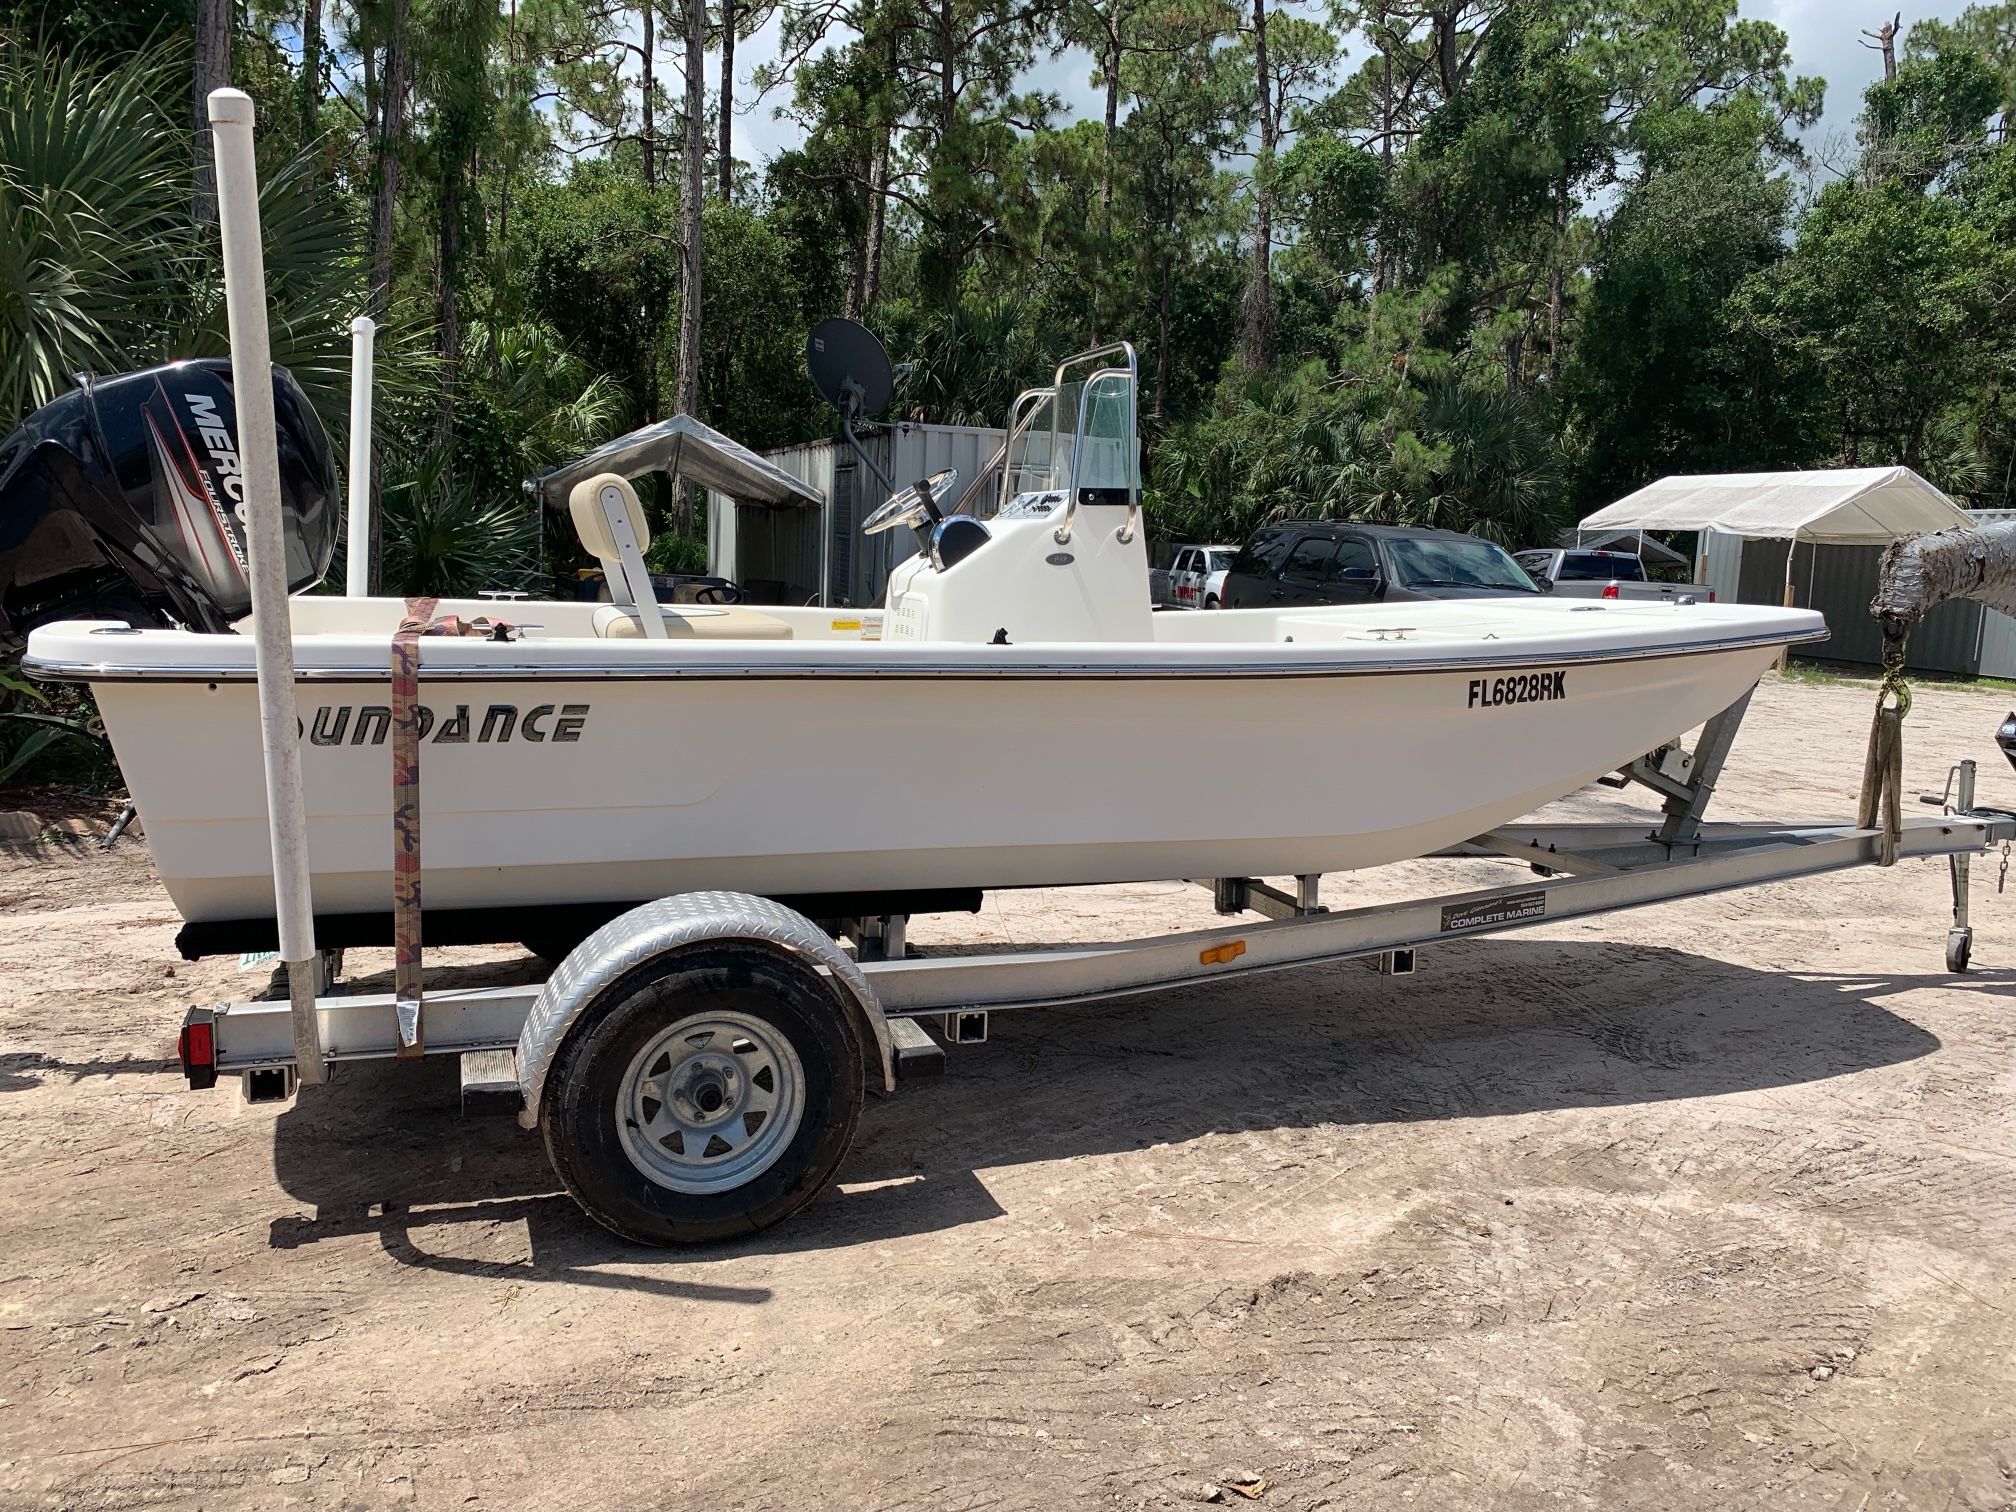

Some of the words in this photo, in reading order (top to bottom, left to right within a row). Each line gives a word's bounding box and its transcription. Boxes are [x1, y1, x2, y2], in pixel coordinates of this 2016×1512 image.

[184, 393, 248, 534] MERC
[199, 470, 249, 573] FOURSTROKE
[1468, 671, 1566, 708] FL6828RK
[297, 704, 590, 746] UNANCE
[1450, 912, 1504, 928] COMPLETE
[1506, 905, 1544, 919] MARINE
